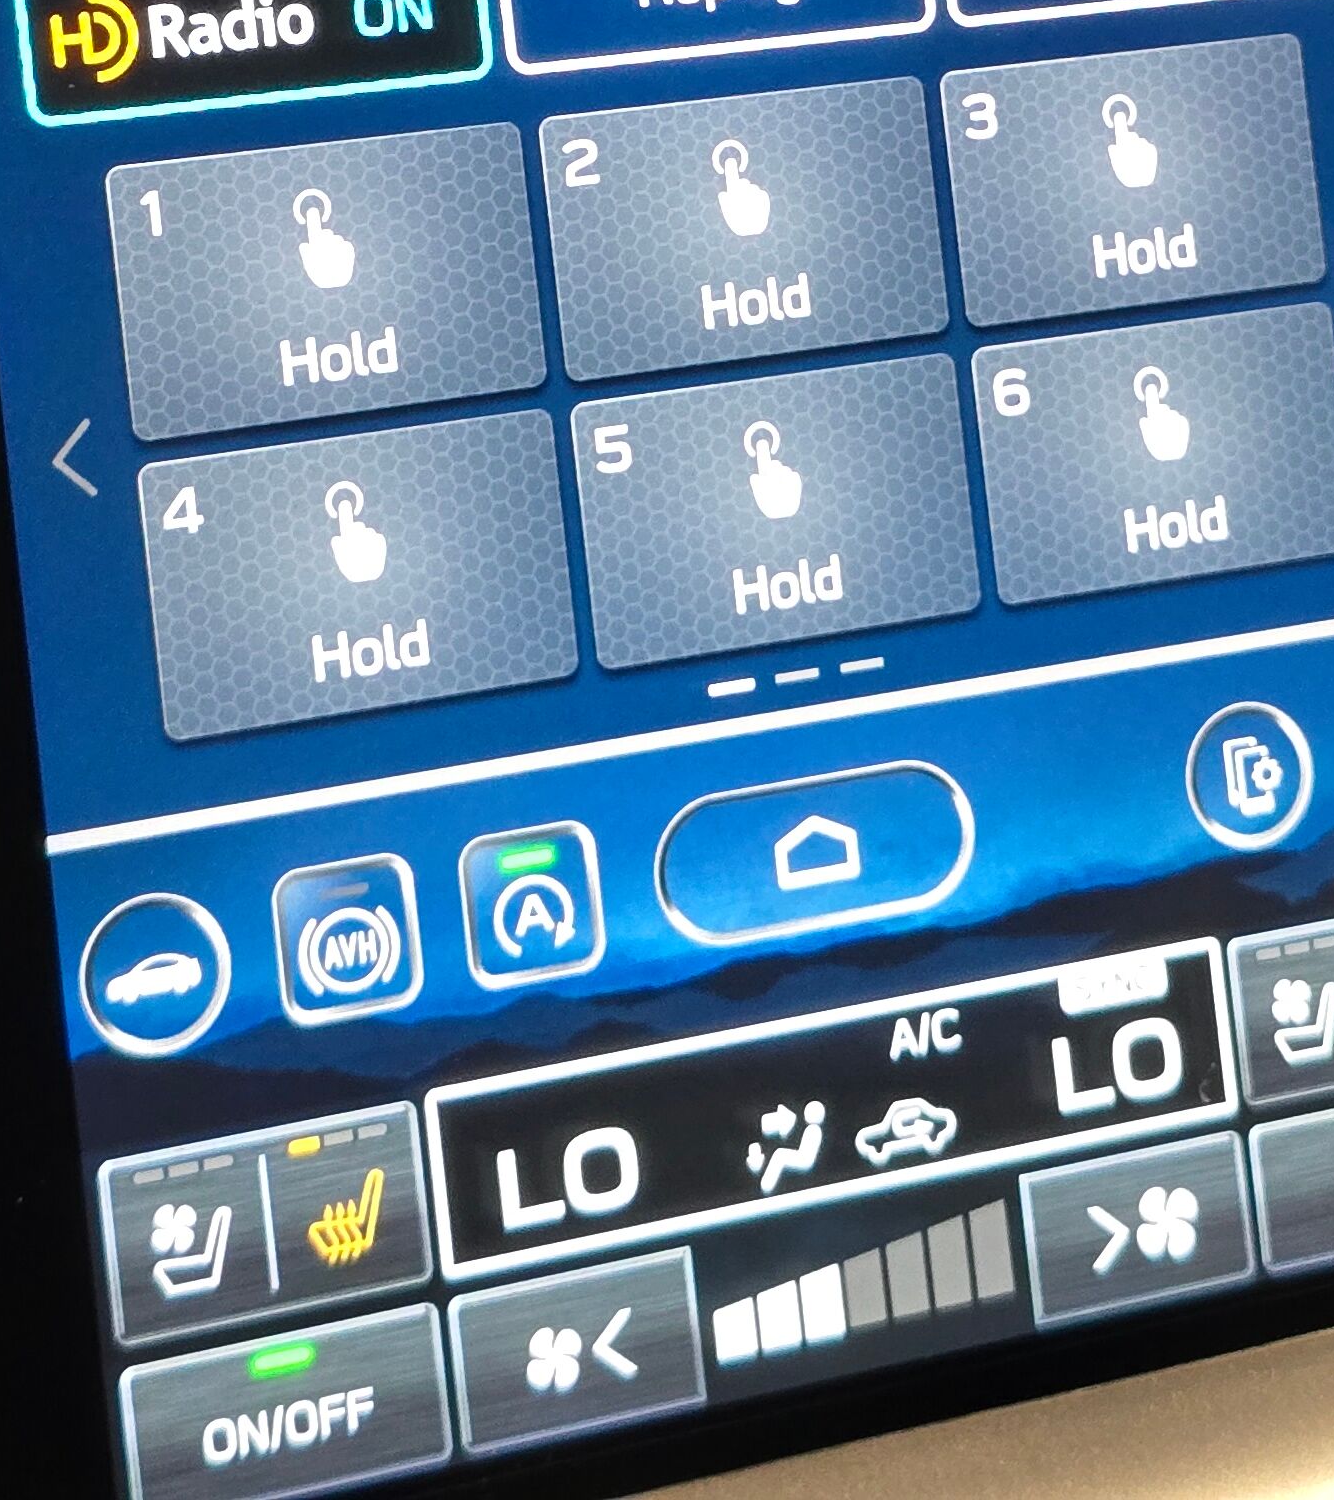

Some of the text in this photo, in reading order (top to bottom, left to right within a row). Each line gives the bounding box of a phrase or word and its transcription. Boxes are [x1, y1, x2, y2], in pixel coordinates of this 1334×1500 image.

[961, 92, 999, 140] 3
[561, 138, 601, 188] 2
[139, 189, 163, 237] 1
[1092, 223, 1198, 279] Hold
[700, 272, 812, 330] Hold
[279, 326, 399, 387] Hold
[992, 367, 1031, 417] 6
[594, 423, 633, 474] 5
[162, 486, 205, 534] 4
[1123, 494, 1229, 554] Hold
[732, 553, 844, 615] Hold
[311, 618, 431, 683] Hold
[324, 933, 378, 969] AVH
[888, 1006, 963, 1061] A/C
[1051, 1017, 1183, 1116] LO
[496, 1126, 640, 1233] LO
[202, 1386, 375, 1465] ON/OFF
